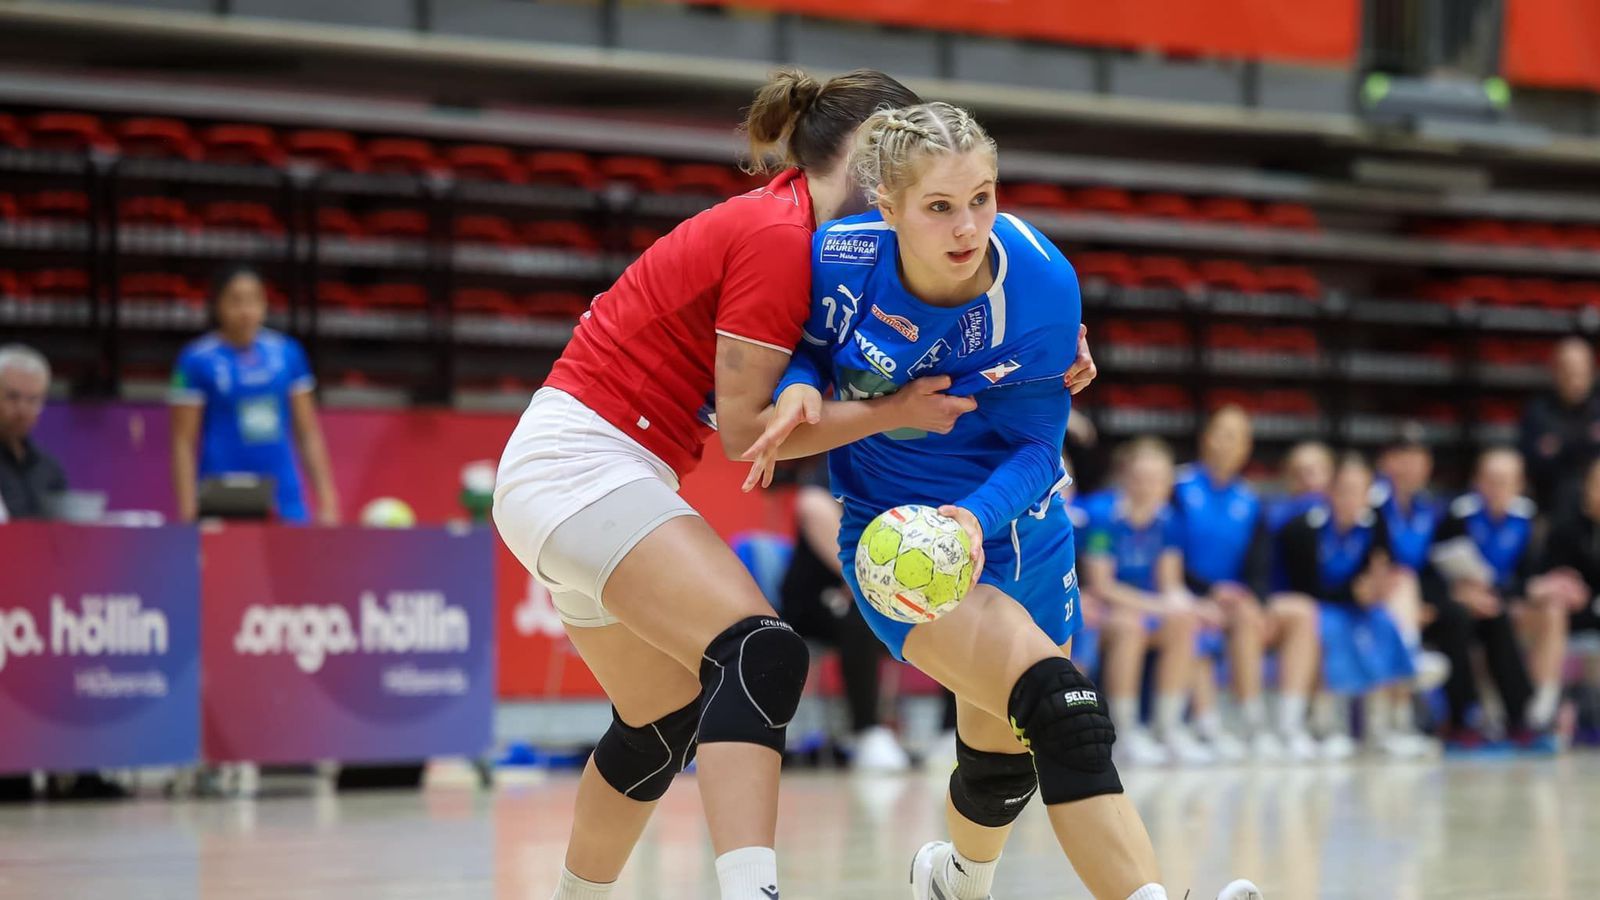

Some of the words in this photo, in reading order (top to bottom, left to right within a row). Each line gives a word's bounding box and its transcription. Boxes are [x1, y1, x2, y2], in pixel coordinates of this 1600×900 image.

[826, 239, 874, 248] BILALEIGA
[824, 245, 875, 254] AKUREYRAR
[51, 595, 168, 654] höllin
[1064, 690, 1097, 703] SELECT
